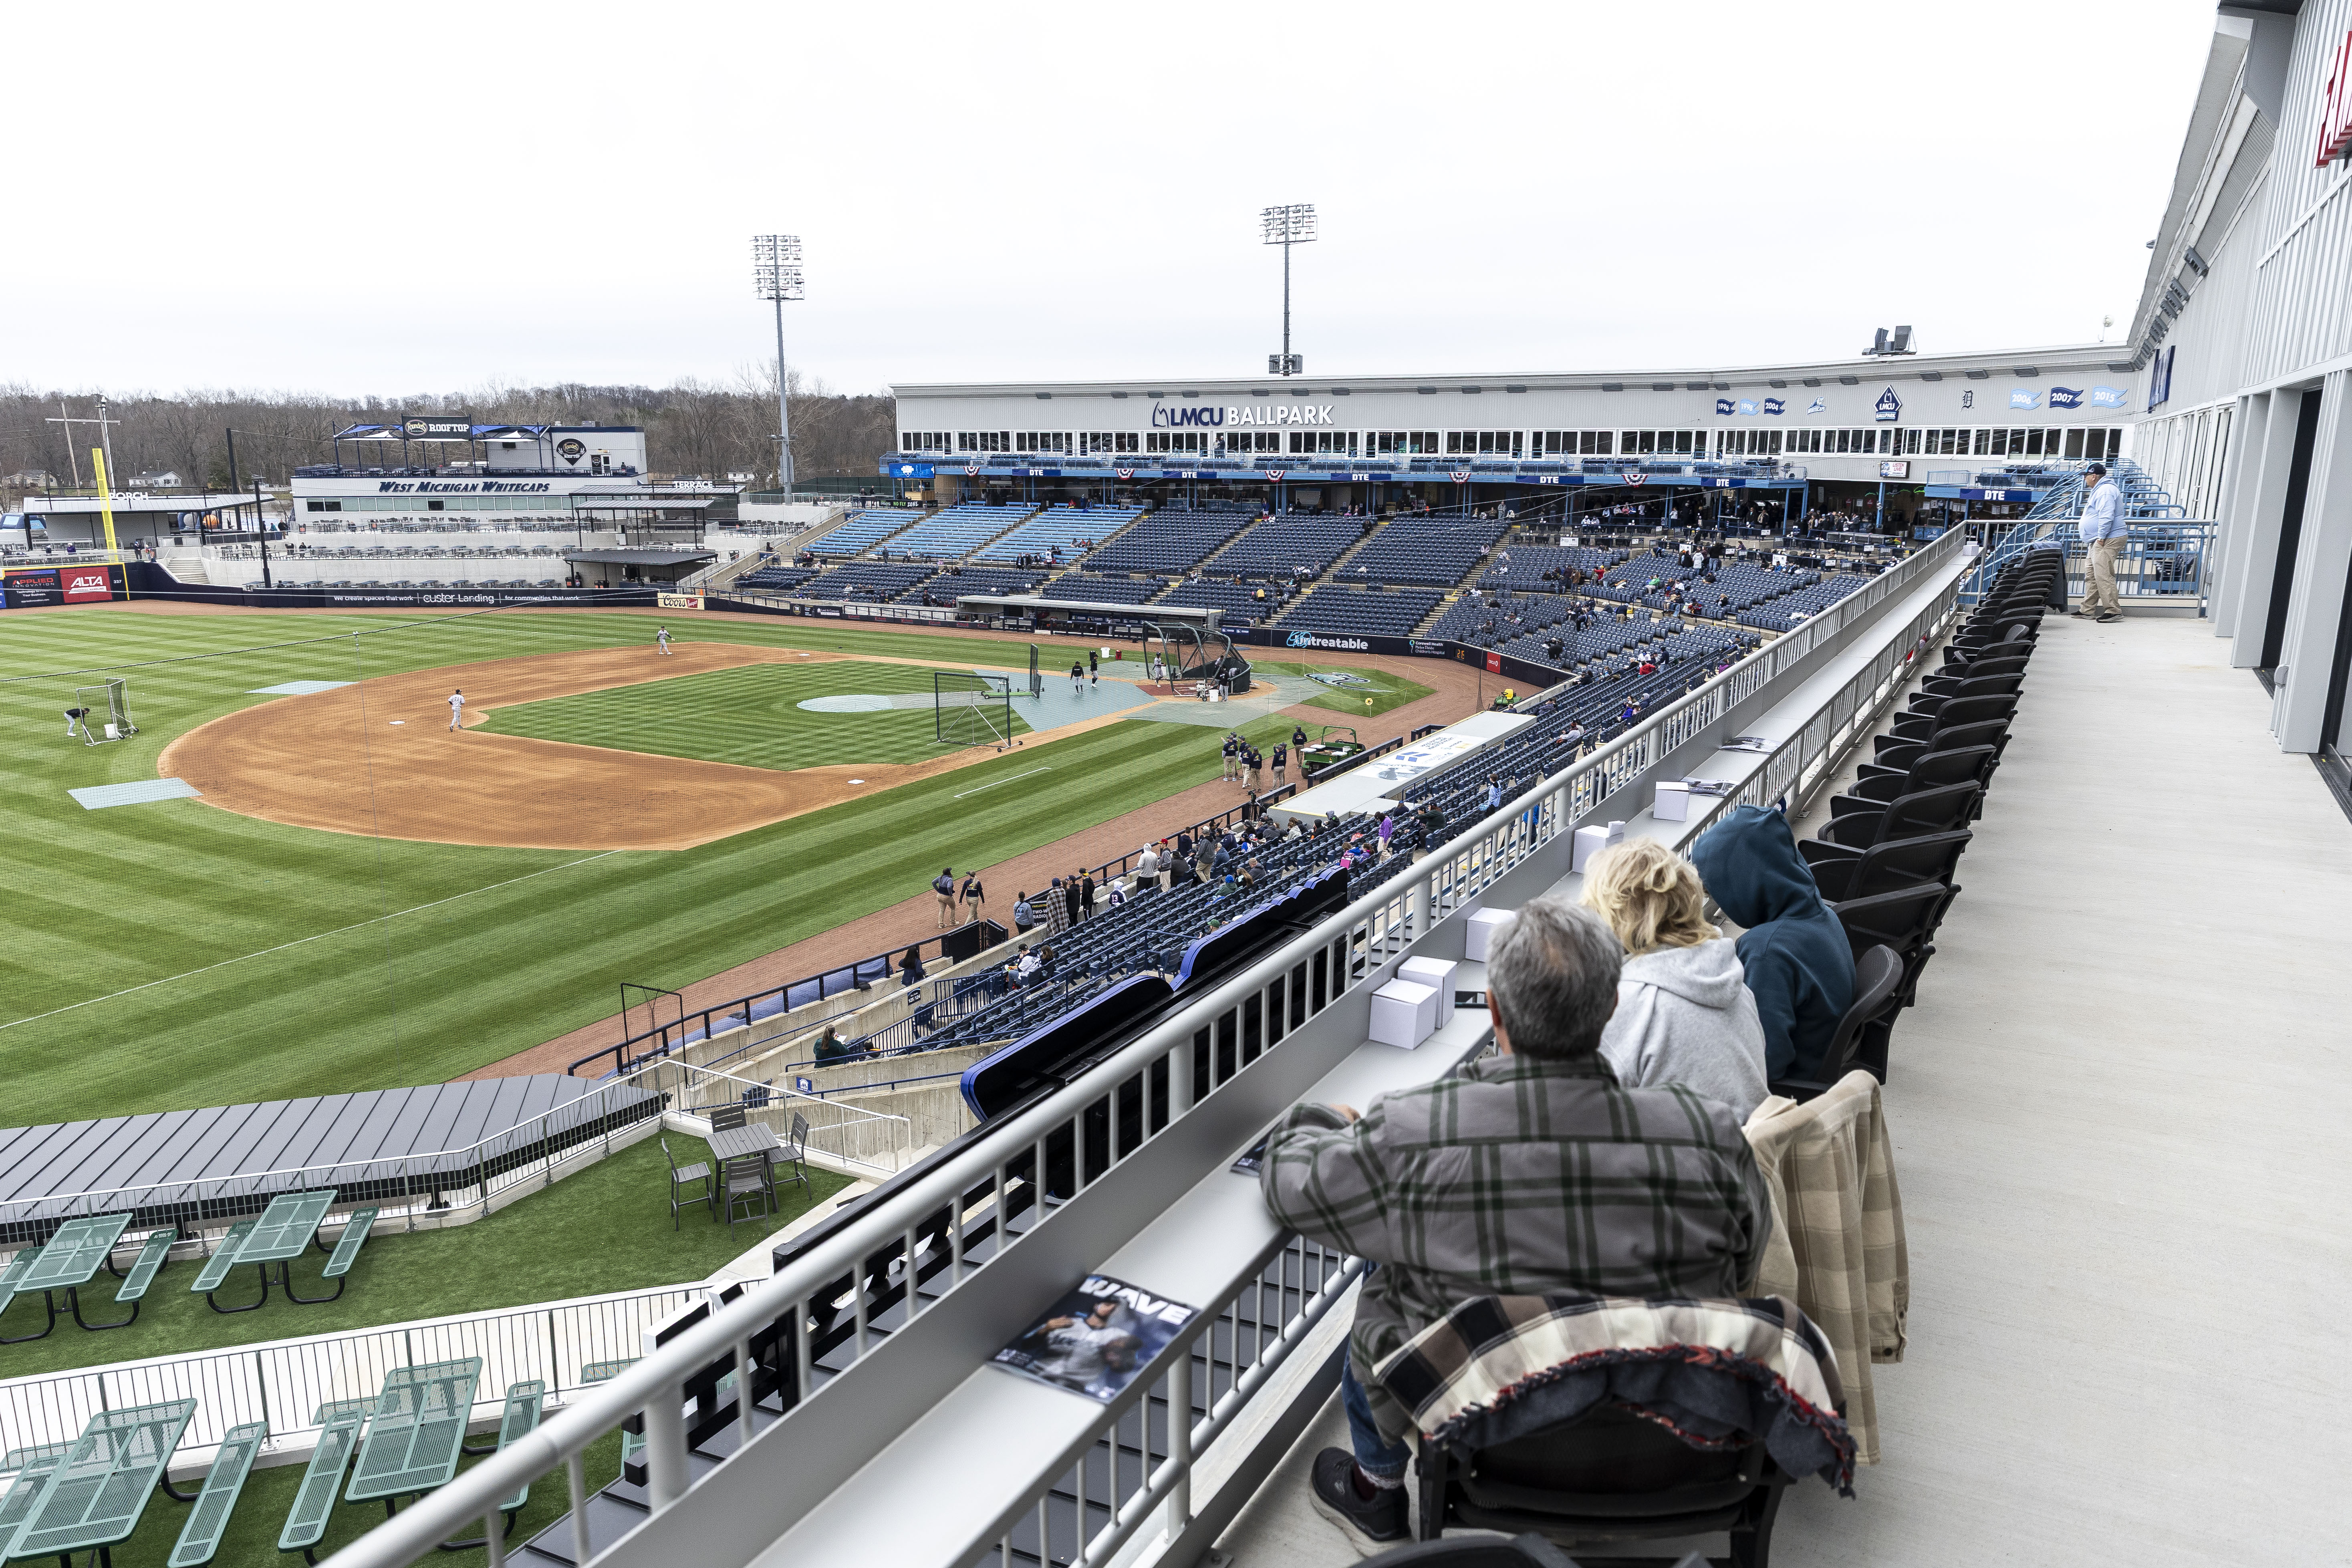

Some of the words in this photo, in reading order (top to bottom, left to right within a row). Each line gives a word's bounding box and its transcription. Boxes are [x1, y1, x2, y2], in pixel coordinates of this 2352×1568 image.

[2012, 393, 2032, 404] 2006
[2052, 393, 2074, 403] 2007
[2094, 391, 2116, 401] 2015
[1718, 403, 1729, 411] 1996
[1741, 403, 1753, 411] 1998
[1765, 402, 1779, 411] 2004
[1171, 407, 1223, 426] LMCU
[1227, 405, 1334, 425] BALLPARK
[428, 423, 469, 432] ROOFTOP
[379, 481, 415, 492] WEST
[415, 481, 480, 492] MICHIGAN
[481, 481, 550, 492] WHITECAPS
[673, 481, 713, 489] TERRACE
[1716, 479, 1729, 487] DTE
[109, 492, 149, 500] PORCH
[1984, 490, 2005, 500] DTE
[71, 576, 103, 587] ALTA
[458, 594, 494, 604] Landing
[663, 595, 686, 607] Coors
[1295, 635, 1368, 649] Untreatable
